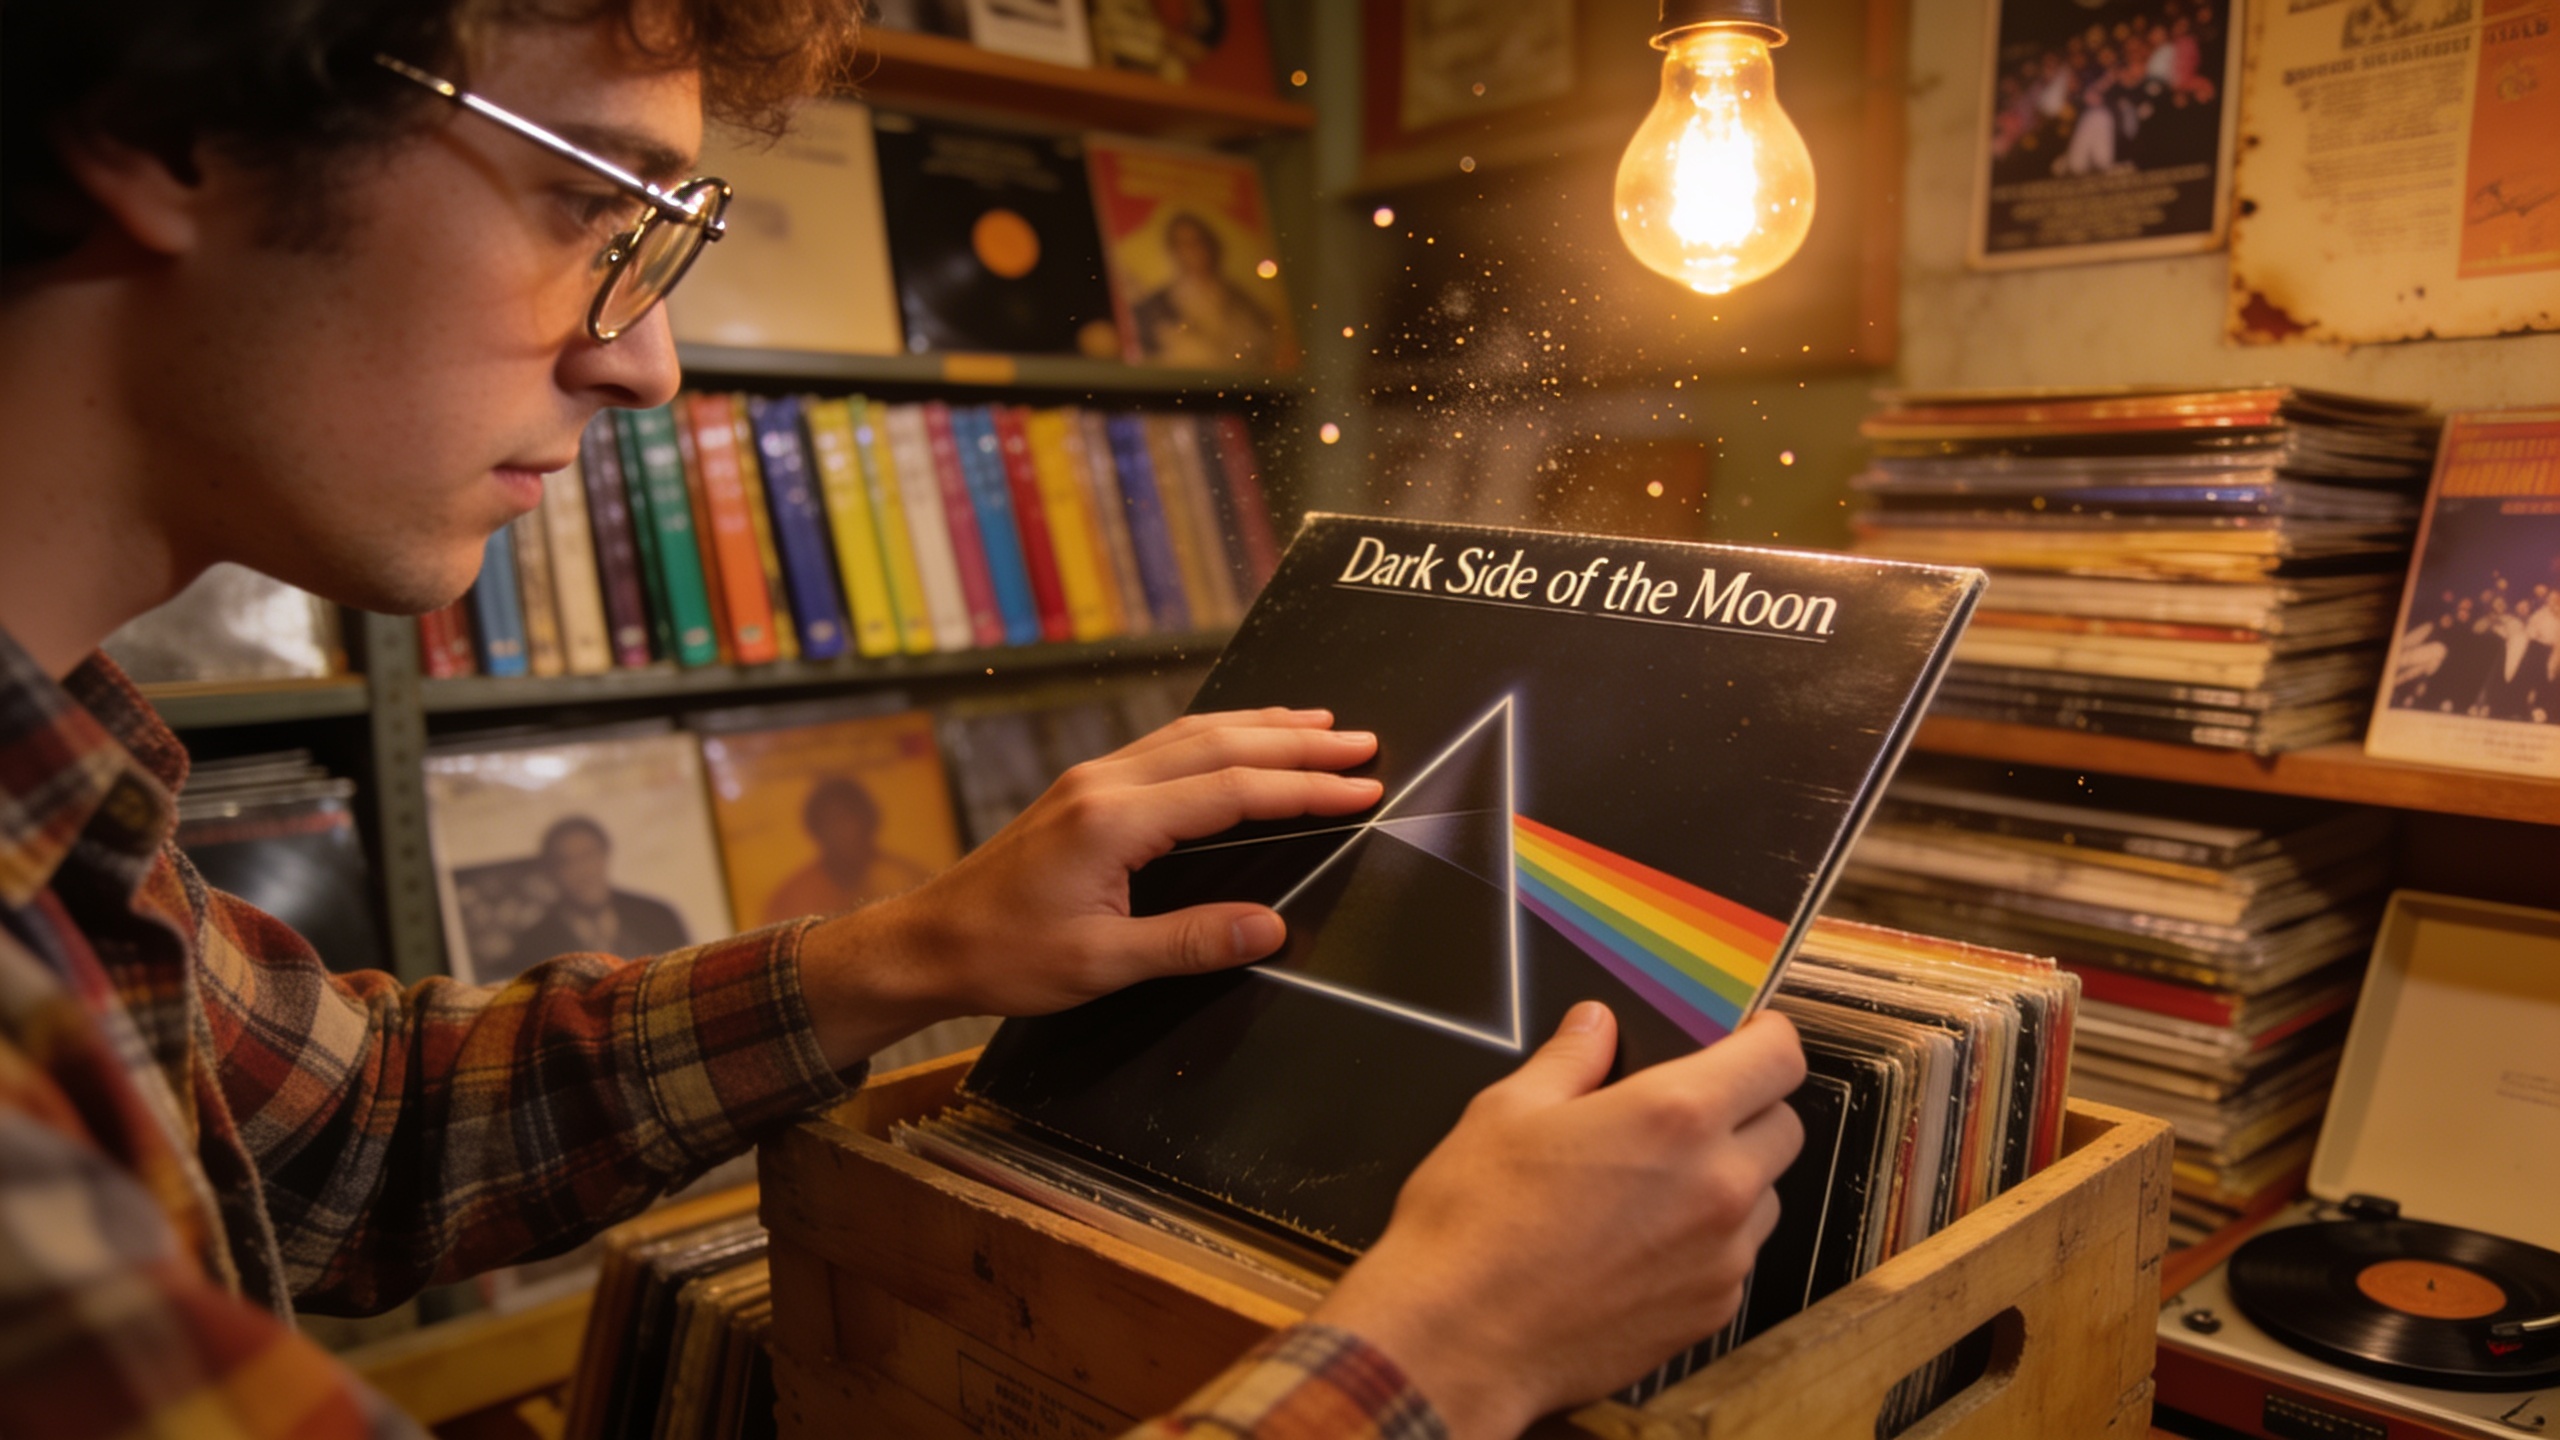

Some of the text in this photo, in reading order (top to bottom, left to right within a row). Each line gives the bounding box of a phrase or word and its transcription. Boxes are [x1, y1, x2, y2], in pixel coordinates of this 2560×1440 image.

[1338, 536, 1444, 592] Dark
[1444, 545, 1540, 601] Side
[1545, 556, 1610, 609] of
[1603, 560, 1679, 616] the
